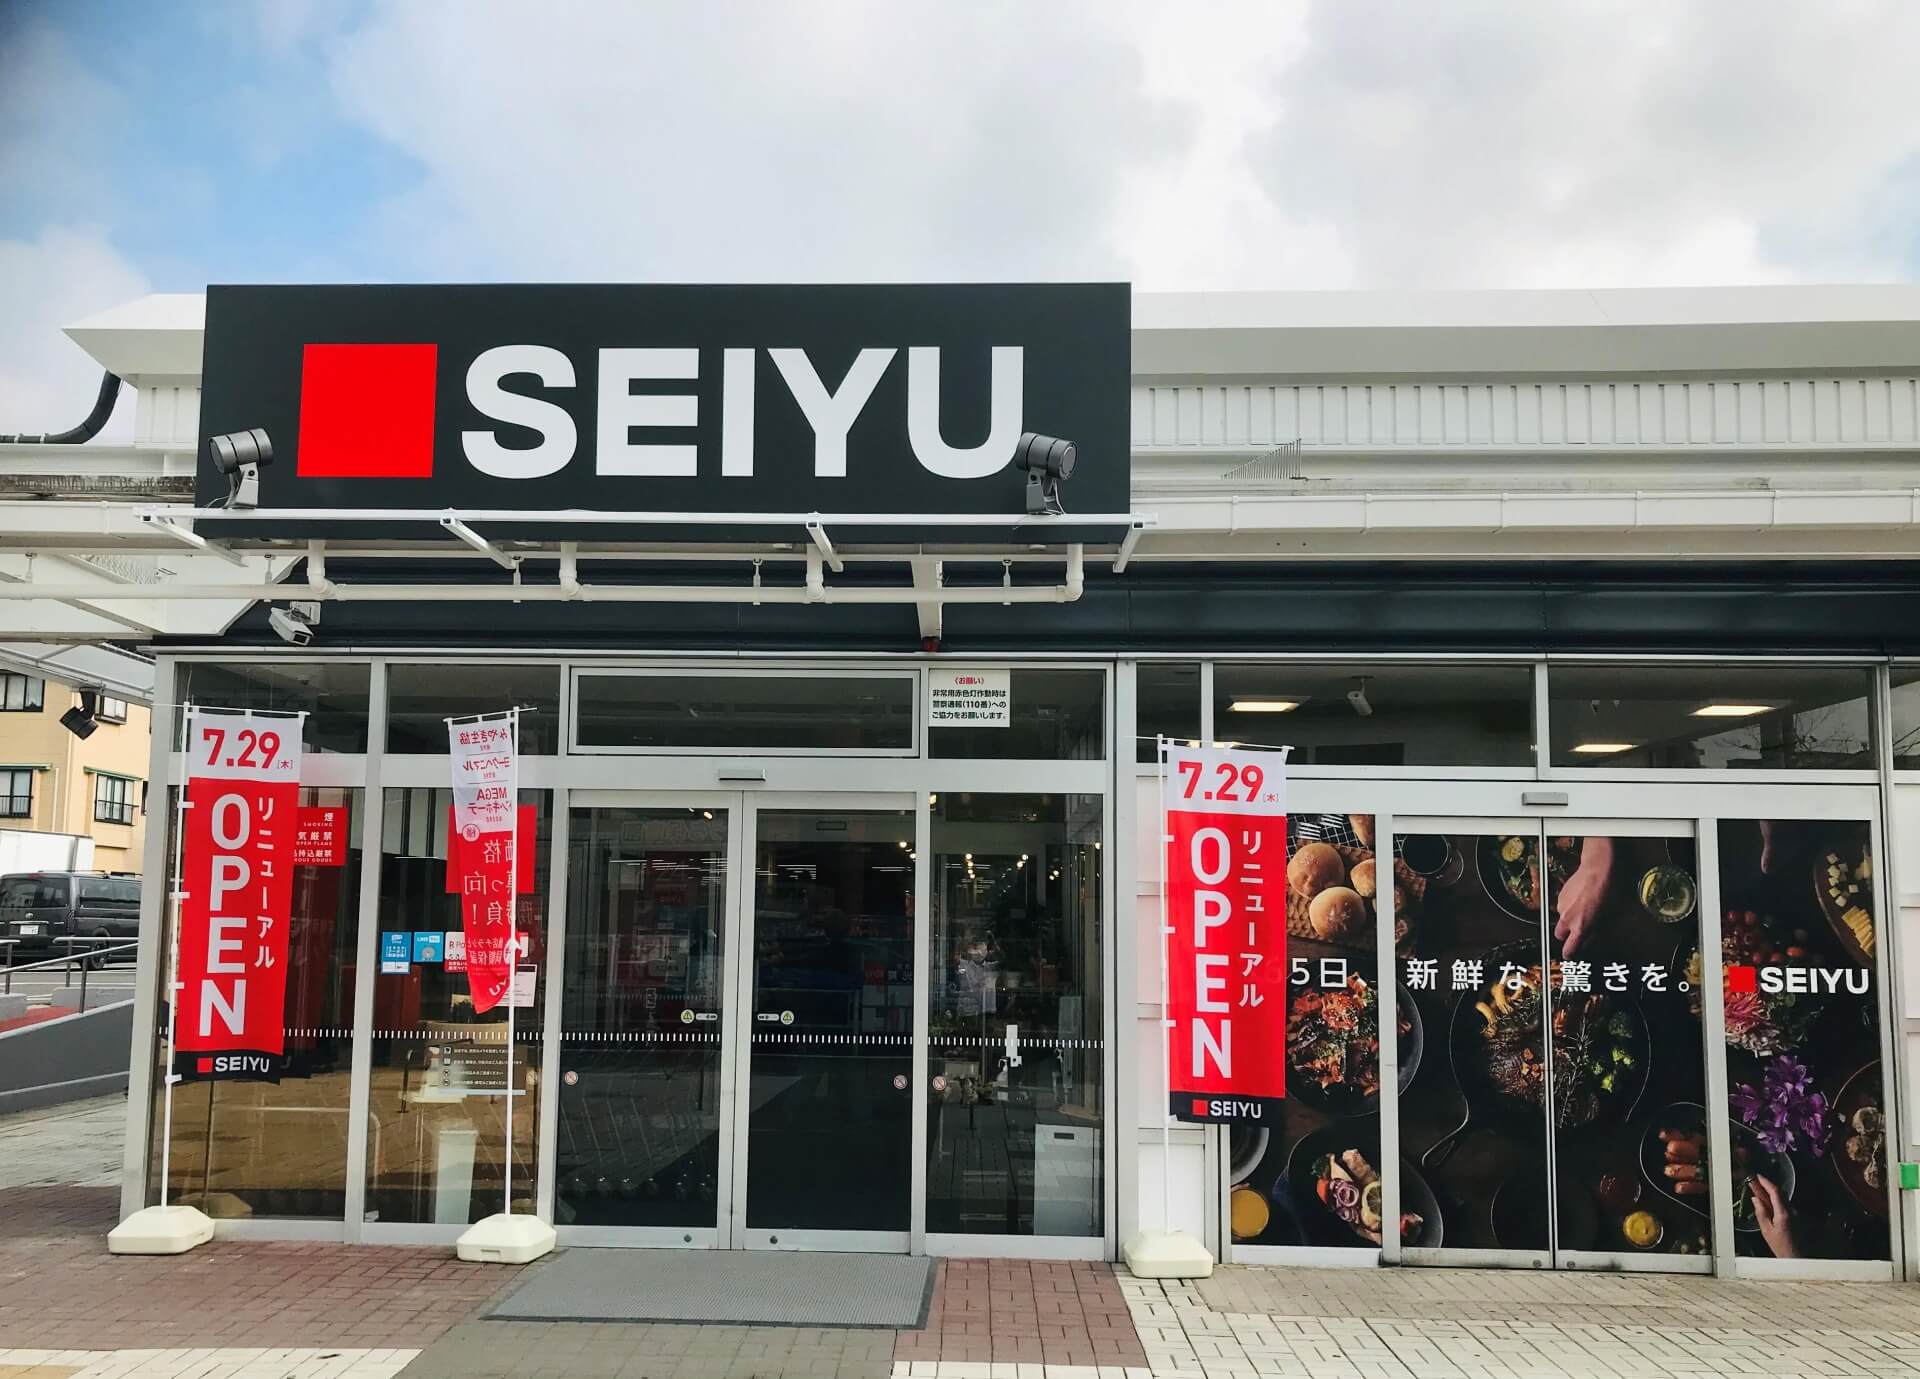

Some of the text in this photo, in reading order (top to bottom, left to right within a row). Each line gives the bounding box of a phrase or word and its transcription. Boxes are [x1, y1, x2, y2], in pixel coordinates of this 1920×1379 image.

[461, 344, 1024, 479] SEIYU
[203, 728, 280, 769] 7.29
[1178, 761, 1264, 802] 7.29
[254, 797, 275, 968] リニューアル
[199, 793, 251, 1036] OPEN
[1238, 830, 1265, 1007] リニューアル
[1191, 827, 1232, 1079] OPEN
[1406, 957, 1690, 993] 新鮮な驚きを。
[1760, 966, 1869, 994] SEIYU
[214, 1055, 270, 1073] SEIYU
[1210, 1100, 1262, 1119] SEIYU
